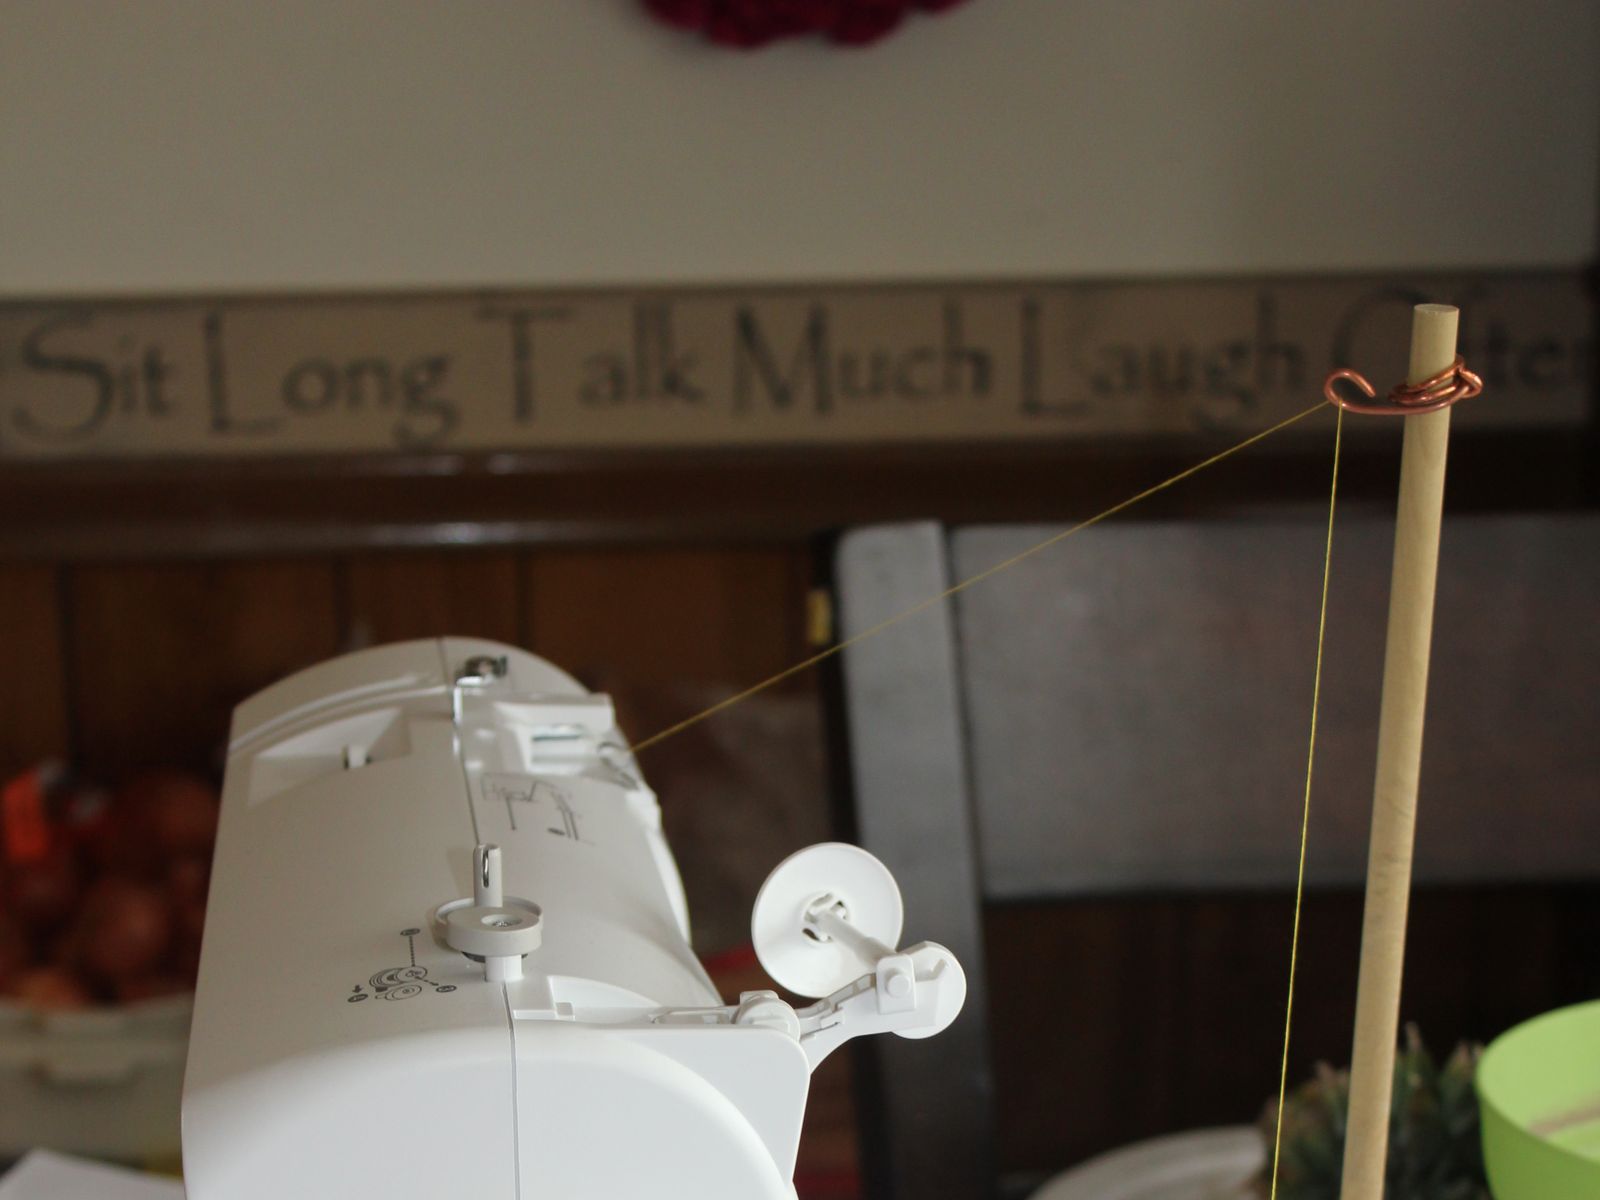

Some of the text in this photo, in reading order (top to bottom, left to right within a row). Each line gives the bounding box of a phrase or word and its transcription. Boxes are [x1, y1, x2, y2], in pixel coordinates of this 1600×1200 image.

[10, 306, 176, 440] Sit
[205, 308, 462, 453] Long
[474, 300, 704, 425] Talk
[731, 294, 993, 418] Much
[1020, 290, 1307, 436] Laugh
